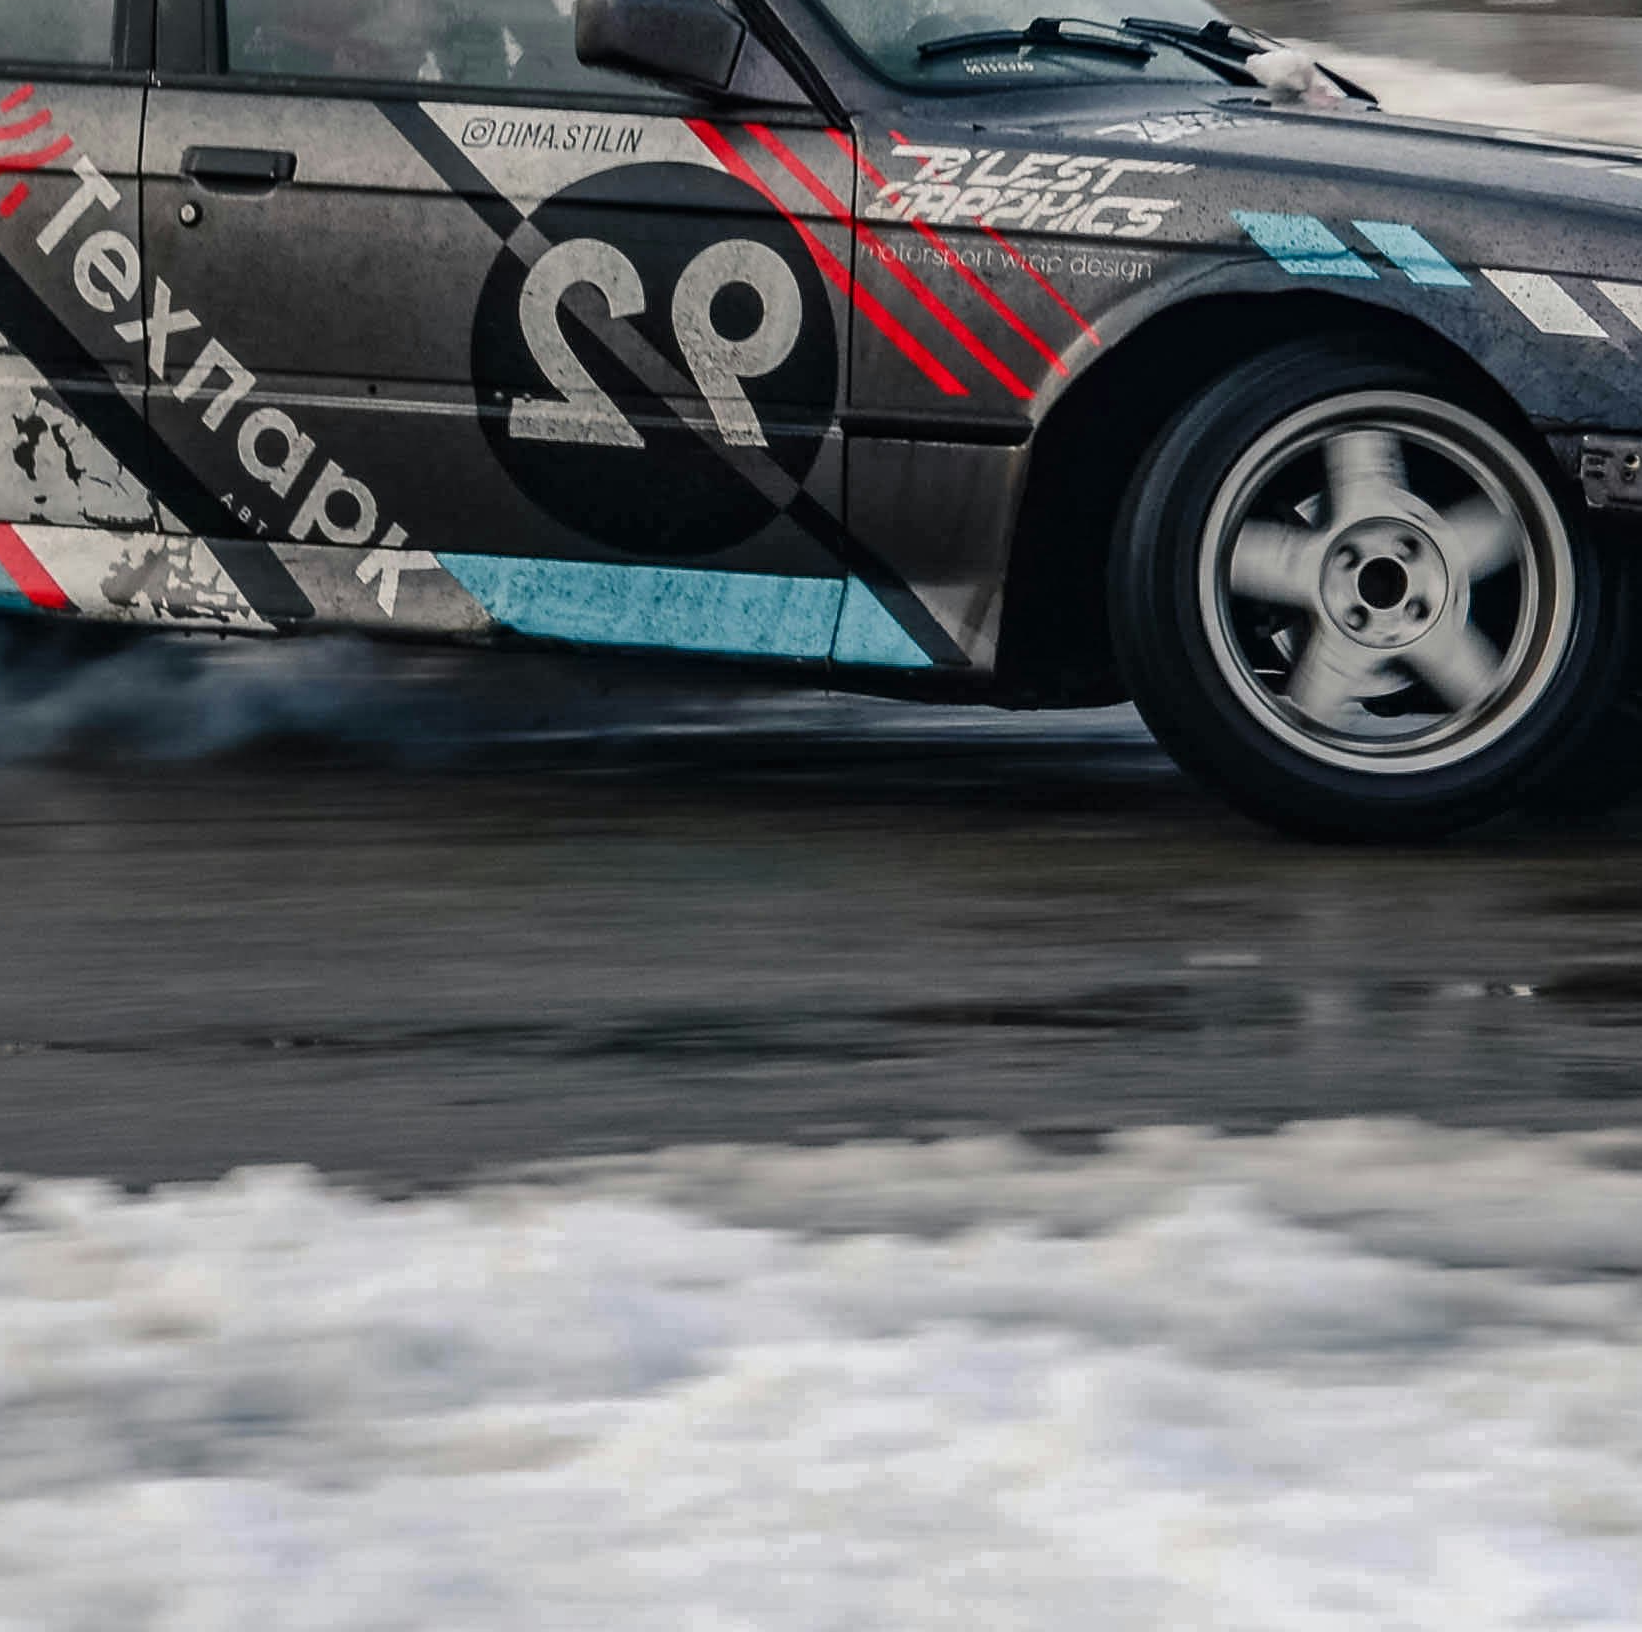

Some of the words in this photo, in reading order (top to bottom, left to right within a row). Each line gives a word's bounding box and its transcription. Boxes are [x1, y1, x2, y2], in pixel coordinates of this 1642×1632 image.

[497, 120, 644, 154] DIMA.STILIN
[1069, 252, 1154, 282] design
[35, 154, 442, 618] Техпарк
